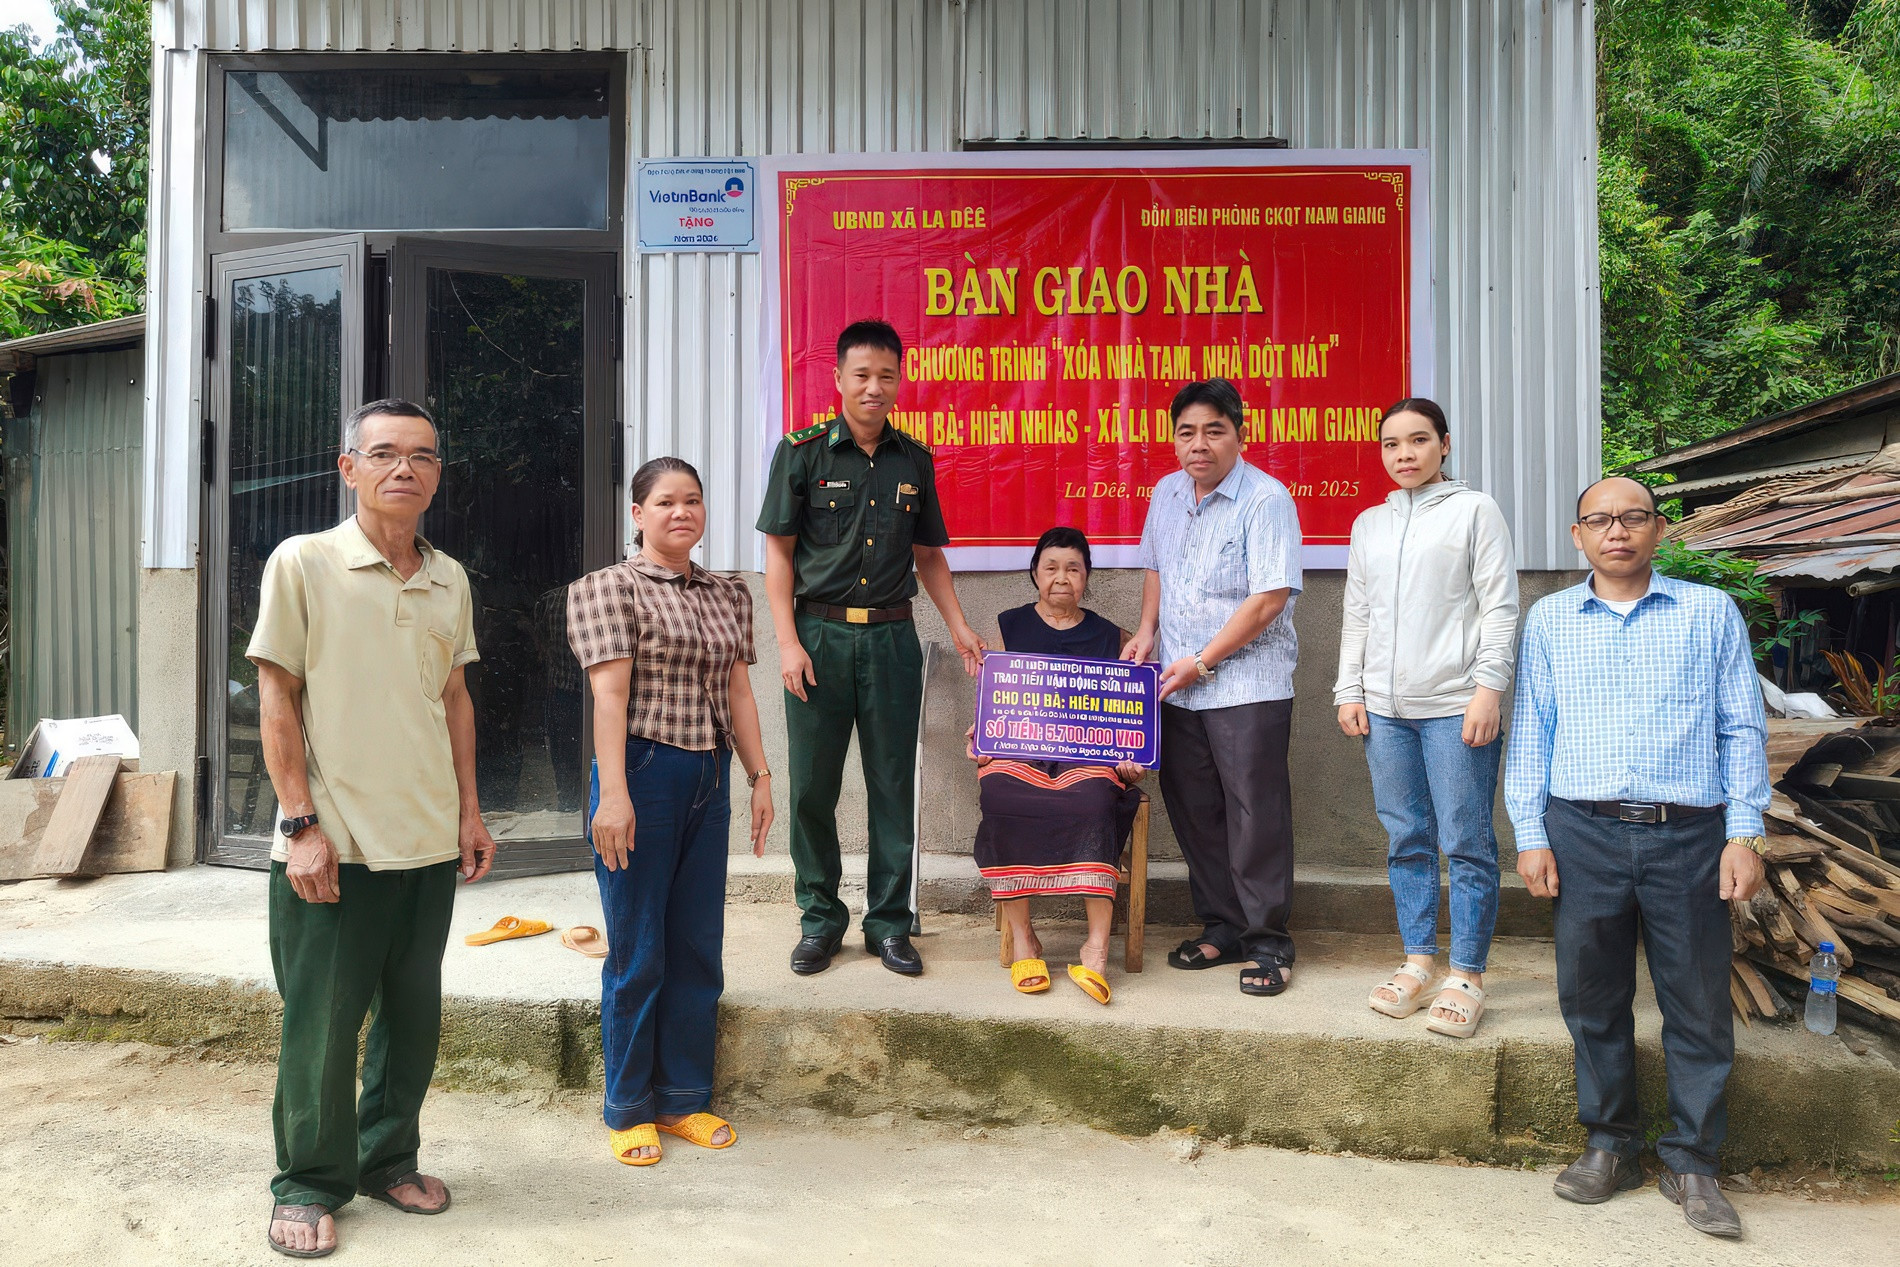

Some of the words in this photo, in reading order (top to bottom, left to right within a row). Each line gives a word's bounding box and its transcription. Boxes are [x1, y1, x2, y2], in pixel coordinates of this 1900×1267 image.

[833, 210, 885, 230] UBND
[891, 207, 917, 229] XÃ
[923, 210, 945, 229] LA
[951, 206, 987, 229] DÊÊ
[1175, 205, 1208, 226] BIÊN
[1212, 203, 1260, 226] PHÒNG
[1265, 207, 1301, 226] CKQT
[1305, 207, 1339, 225] NAM
[1343, 207, 1386, 225] GIANG
[924, 251, 1019, 315] BÀN
[1033, 265, 1148, 315] GIAO
[1163, 249, 1263, 313] NHÀ
[906, 344, 985, 382] CHƯƠNG
[990, 340, 1046, 382] TRÌNH
[1106, 336, 1146, 379] NHÀ
[1149, 345, 1197, 387] TẠM,
[1203, 336, 1243, 380] NHÀ
[1249, 337, 1285, 387] DỘT
[887, 404, 927, 444] ÌNH
[933, 403, 963, 446] BÀ:
[970, 403, 1015, 446] HIÊN
[1021, 403, 1079, 445] NHÍAS
[1097, 402, 1124, 443] XÃ
[1129, 409, 1149, 443] LA
[1272, 408, 1317, 443] NAM
[1324, 408, 1383, 442] GIANG
[1064, 482, 1086, 498] La
[1319, 480, 1360, 497] 2025
[993, 690, 1018, 705] CHO
[1023, 692, 1040, 709] CỤ
[986, 715, 1007, 738] SỐ
[1045, 723, 1113, 746] 5.700.000
